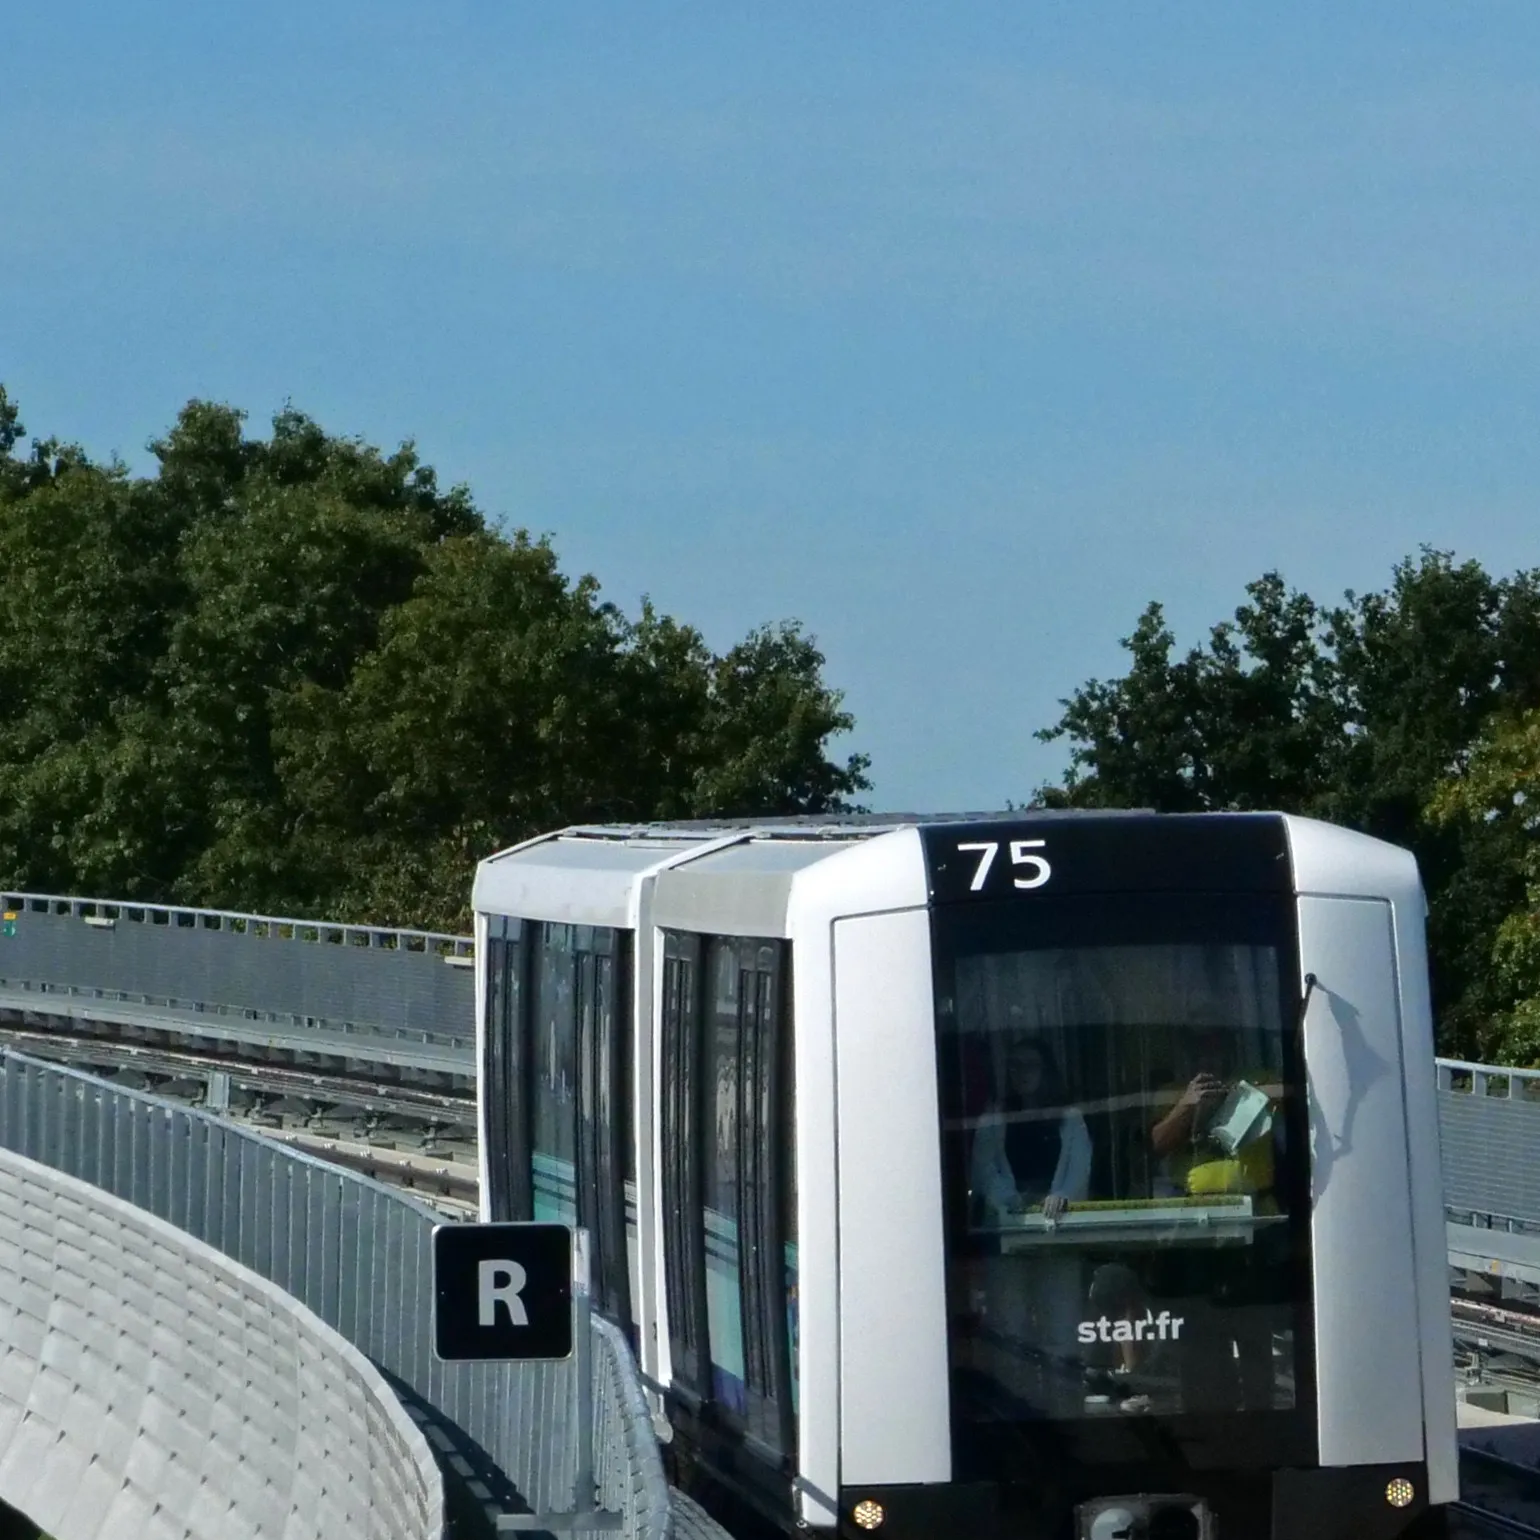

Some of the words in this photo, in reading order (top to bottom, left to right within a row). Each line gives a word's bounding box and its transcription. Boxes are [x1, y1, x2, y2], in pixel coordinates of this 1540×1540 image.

[957, 840, 1052, 891] 75
[478, 1259, 529, 1326] R
[1077, 1310, 1185, 1344] star.fr
